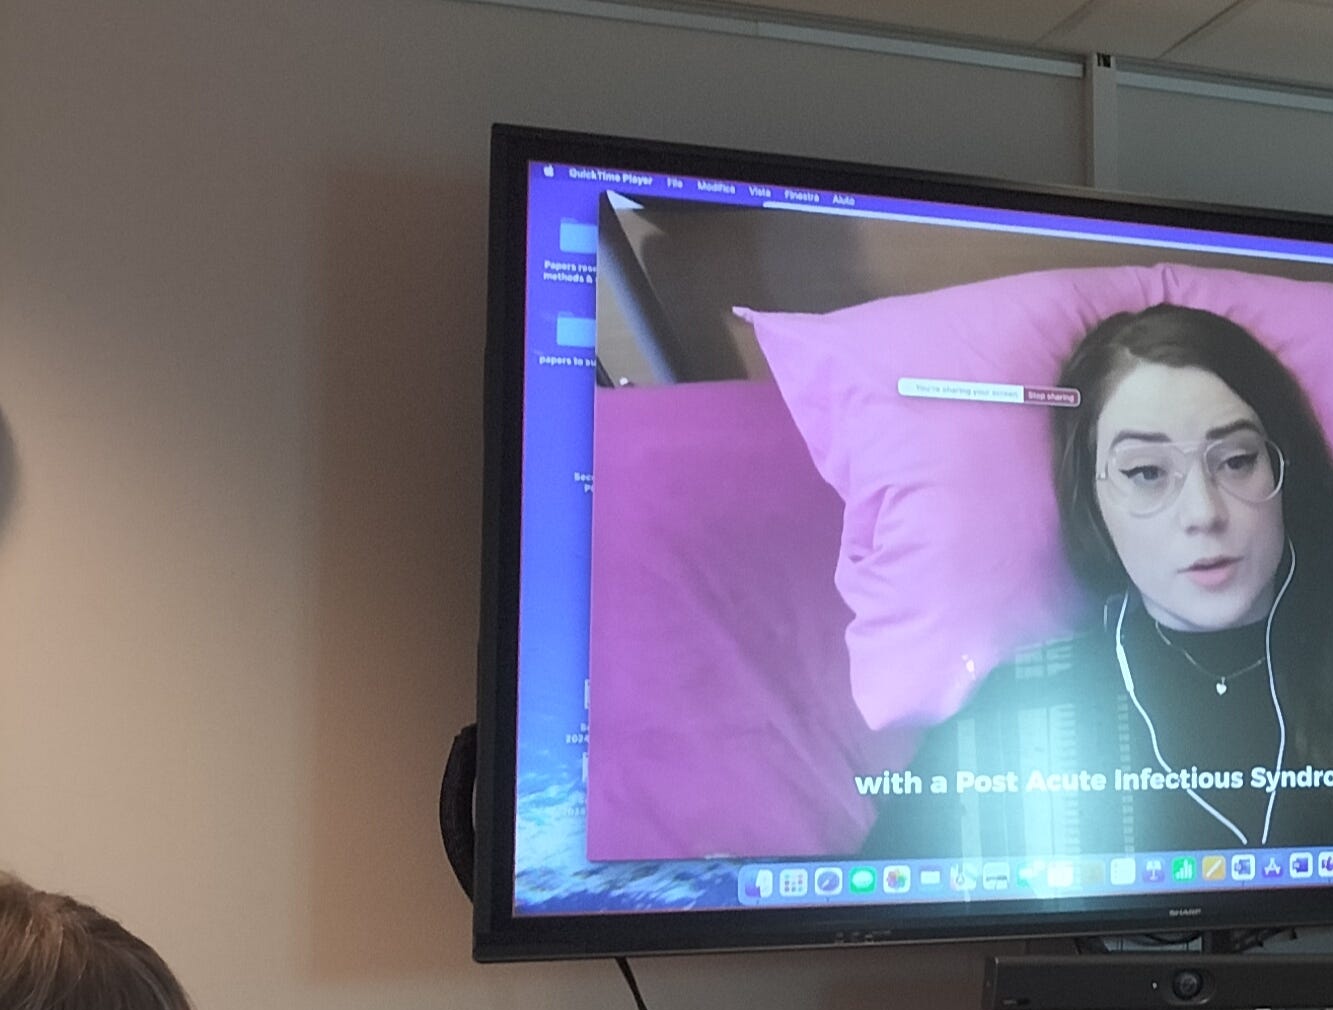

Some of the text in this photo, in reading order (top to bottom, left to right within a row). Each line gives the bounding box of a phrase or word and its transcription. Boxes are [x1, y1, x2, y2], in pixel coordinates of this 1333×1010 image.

[622, 173, 653, 187] Player
[855, 769, 922, 795] with
[930, 774, 948, 794] a
[956, 769, 1019, 794] Post
[1025, 767, 1107, 793] Acute
[1114, 765, 1244, 791] Infectious
